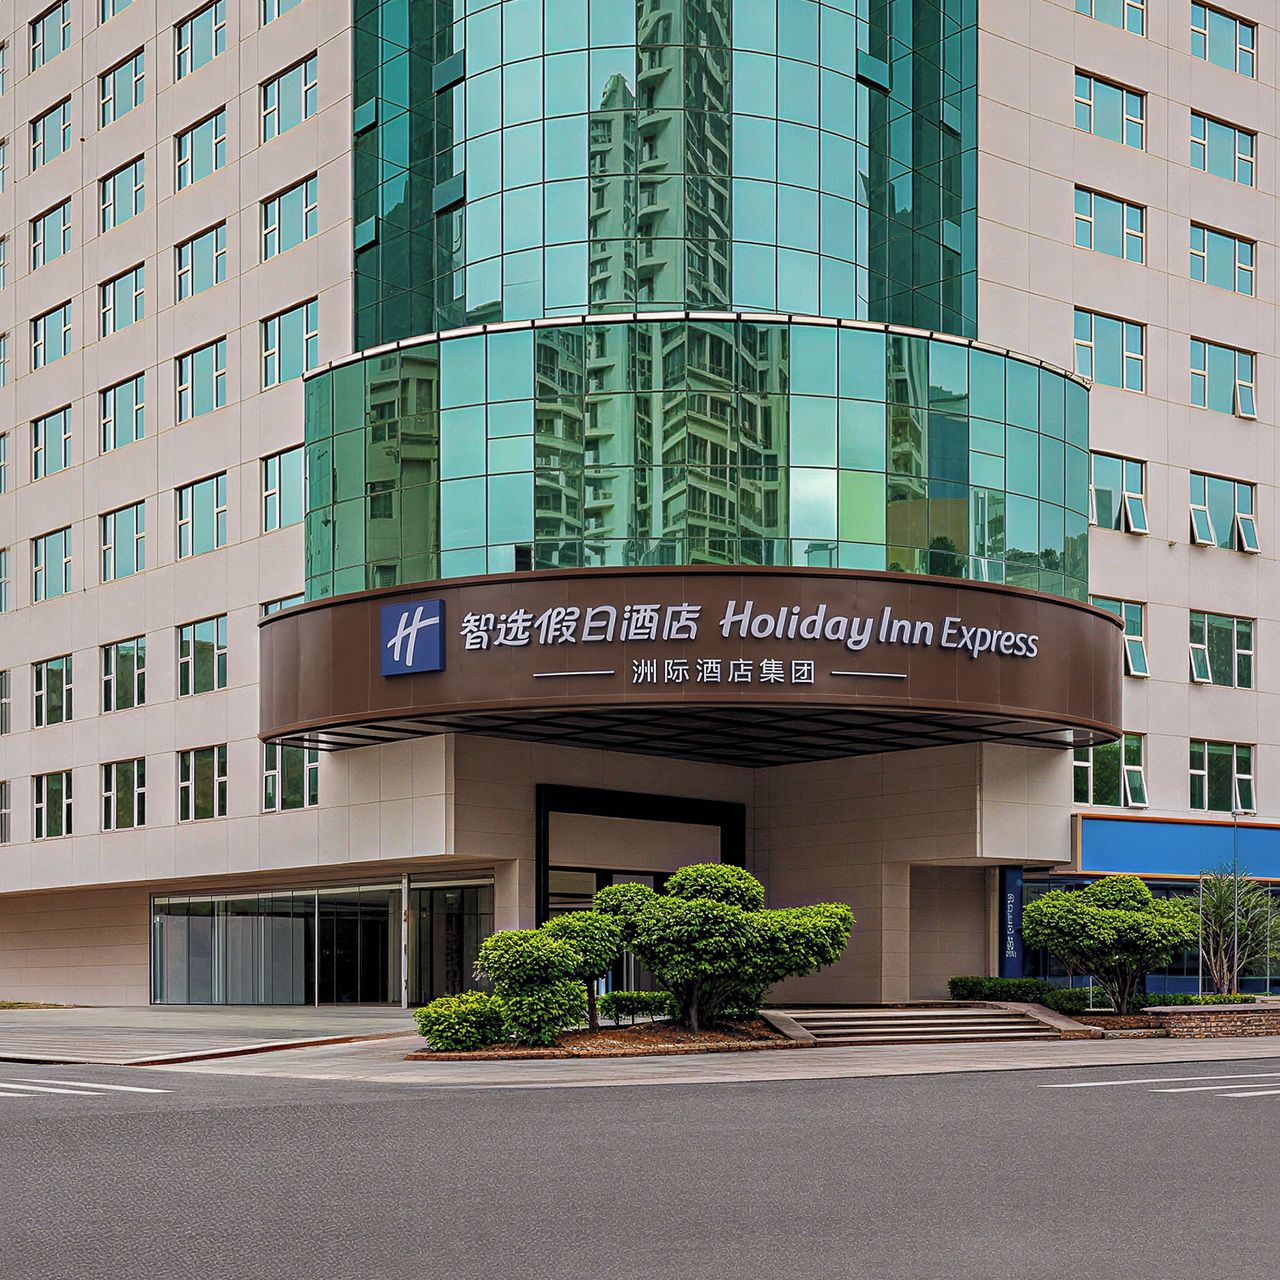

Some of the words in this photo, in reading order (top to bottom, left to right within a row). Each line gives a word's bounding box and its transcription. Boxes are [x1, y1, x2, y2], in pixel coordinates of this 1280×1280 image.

[459, 602, 702, 651] 智选假日酒店
[719, 600, 874, 651] Holiday
[878, 606, 934, 646] Inn
[940, 616, 1040, 659] Express
[631, 658, 815, 684] 洲际酒店集团
